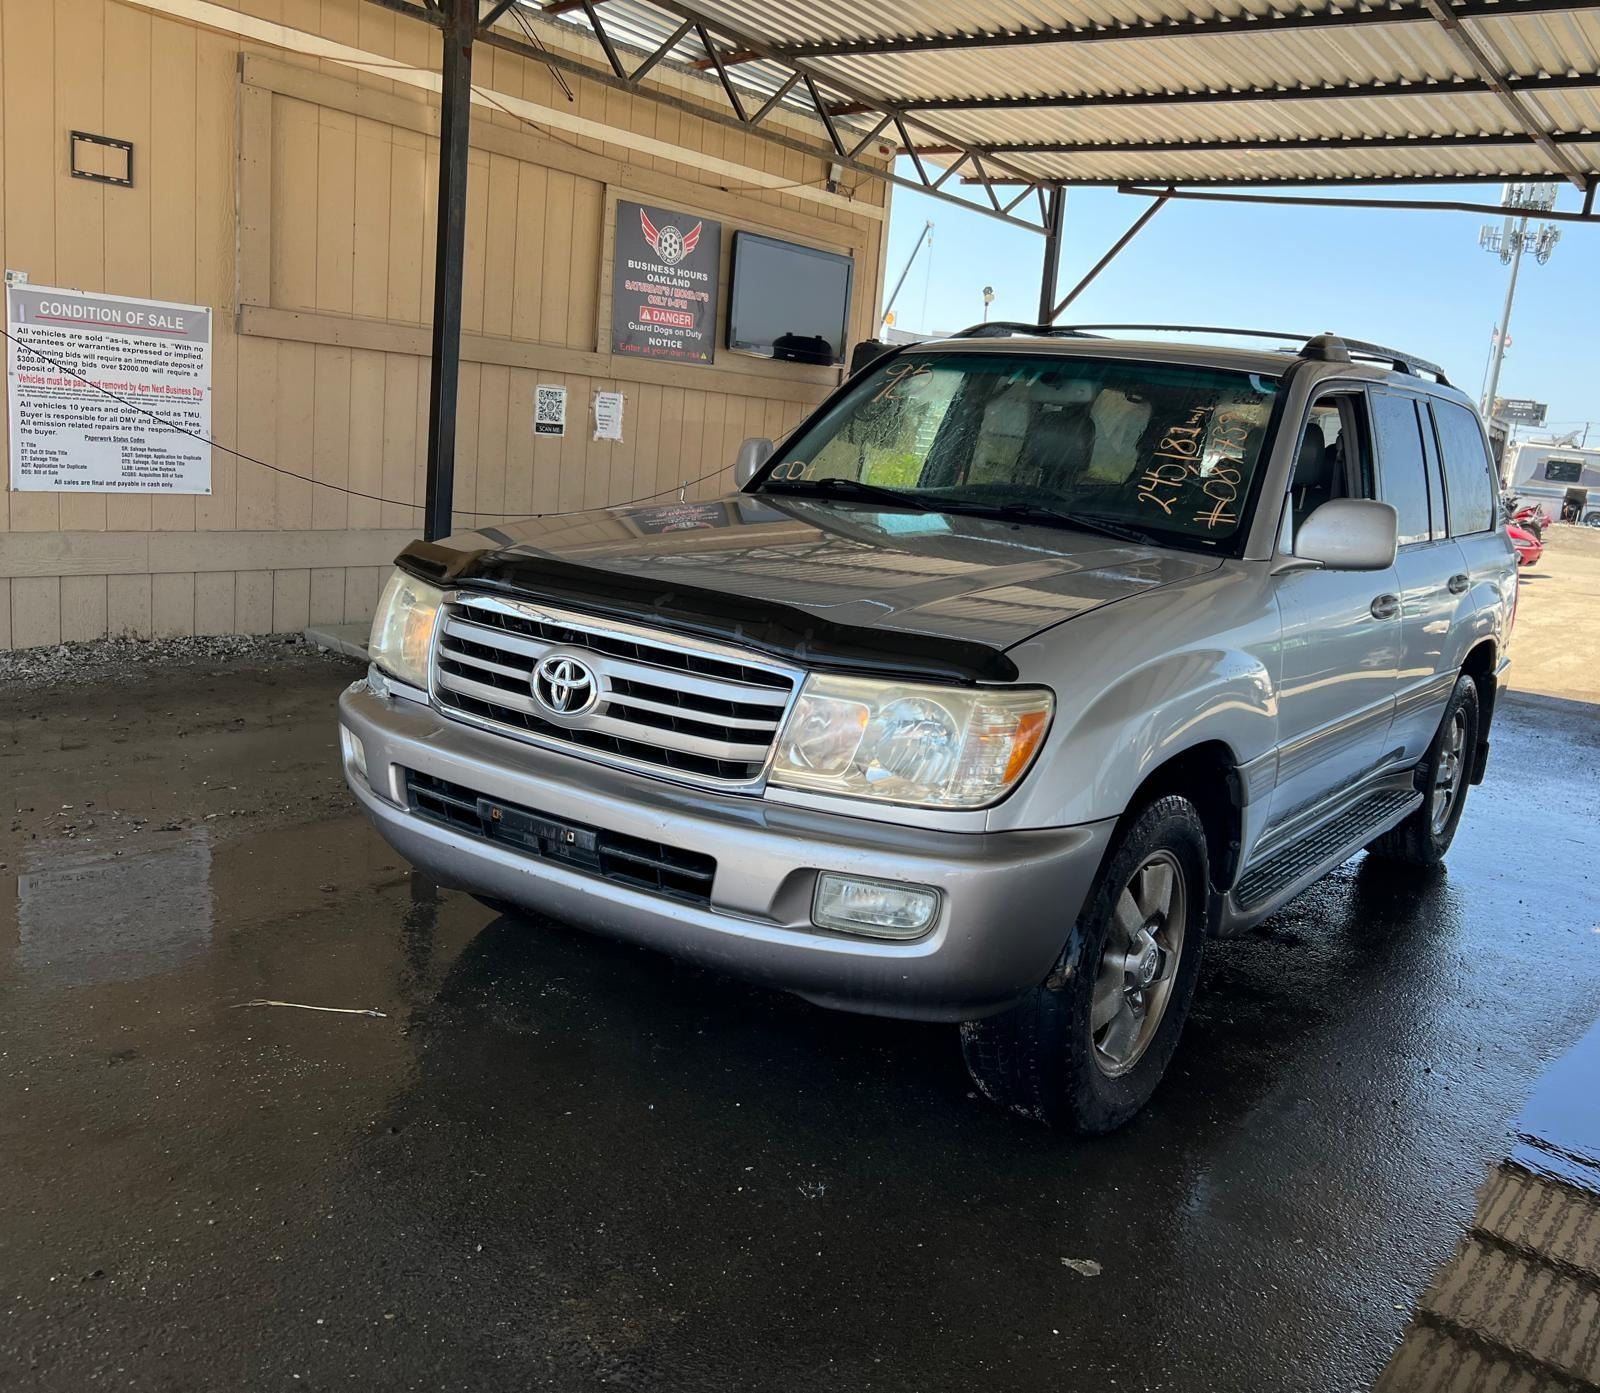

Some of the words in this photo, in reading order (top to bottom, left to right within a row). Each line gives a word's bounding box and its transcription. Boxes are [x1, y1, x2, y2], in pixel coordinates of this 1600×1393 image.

[628, 260, 675, 275] BUSINESS
[677, 268, 708, 281] HOURS
[646, 274, 690, 288] OAKLAND
[40, 301, 121, 322] CONDITION
[126, 312, 145, 324] OF
[148, 314, 184, 329] SALE
[653, 310, 691, 326] DANGER
[31, 329, 66, 338] vehicles
[628, 322, 652, 332] Guard
[654, 326, 672, 335] Dogs
[685, 330, 702, 340] Duty
[17, 338, 64, 346] guarantees
[78, 343, 120, 351] warranties
[122, 347, 162, 356] expressed
[174, 352, 203, 360] implied.
[620, 343, 640, 352] Enter
[648, 338, 682, 348] NOTICE
[17, 347, 31, 355] Any
[134, 358, 169, 366] immediate
[170, 362, 195, 370] deposit
[17, 355, 45, 363] $300.00
[48, 358, 77, 368] Winning
[119, 364, 148, 372] $2000.00
[18, 374, 45, 384] Vehicles
[46, 377, 62, 386] must
[64, 378, 71, 386] be
[74, 379, 86, 388] paid
[90, 380, 100, 388] and
[102, 382, 127, 390] removed
[129, 382, 136, 393] by
[138, 383, 150, 394] 4pm
[152, 384, 164, 393] Next
[166, 385, 191, 395] Business
[192, 387, 203, 397] Day
